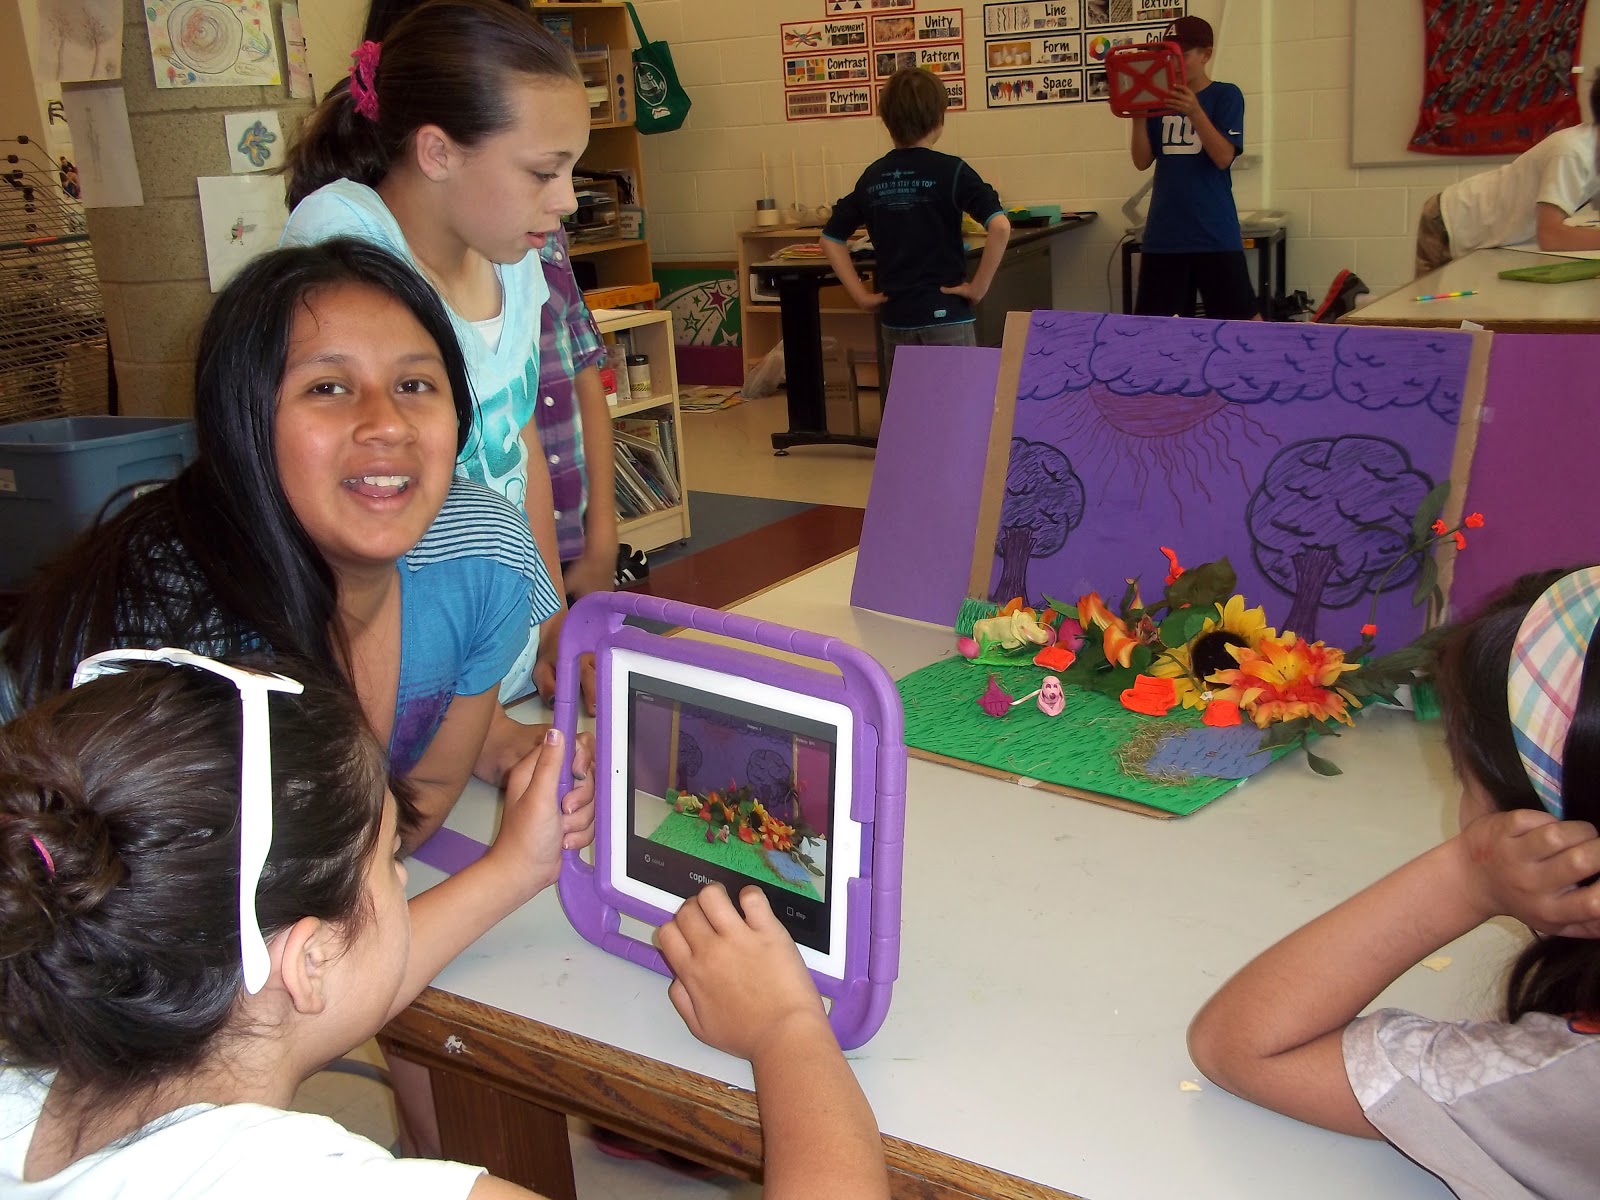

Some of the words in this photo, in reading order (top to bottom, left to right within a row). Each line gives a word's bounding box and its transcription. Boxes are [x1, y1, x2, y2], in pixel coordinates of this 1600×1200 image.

[1044, 3, 1066, 17] Line
[824, 22, 865, 34] Movement
[924, 15, 953, 29] Unity
[1147, 32, 1163, 43] Col
[1043, 40, 1070, 53] Form
[921, 49, 960, 63] Pattern
[827, 57, 867, 70] Contrast
[945, 84, 963, 96] asis
[1042, 77, 1073, 90] Space
[829, 90, 868, 105] Rhythm
[689, 871, 716, 885] captur
